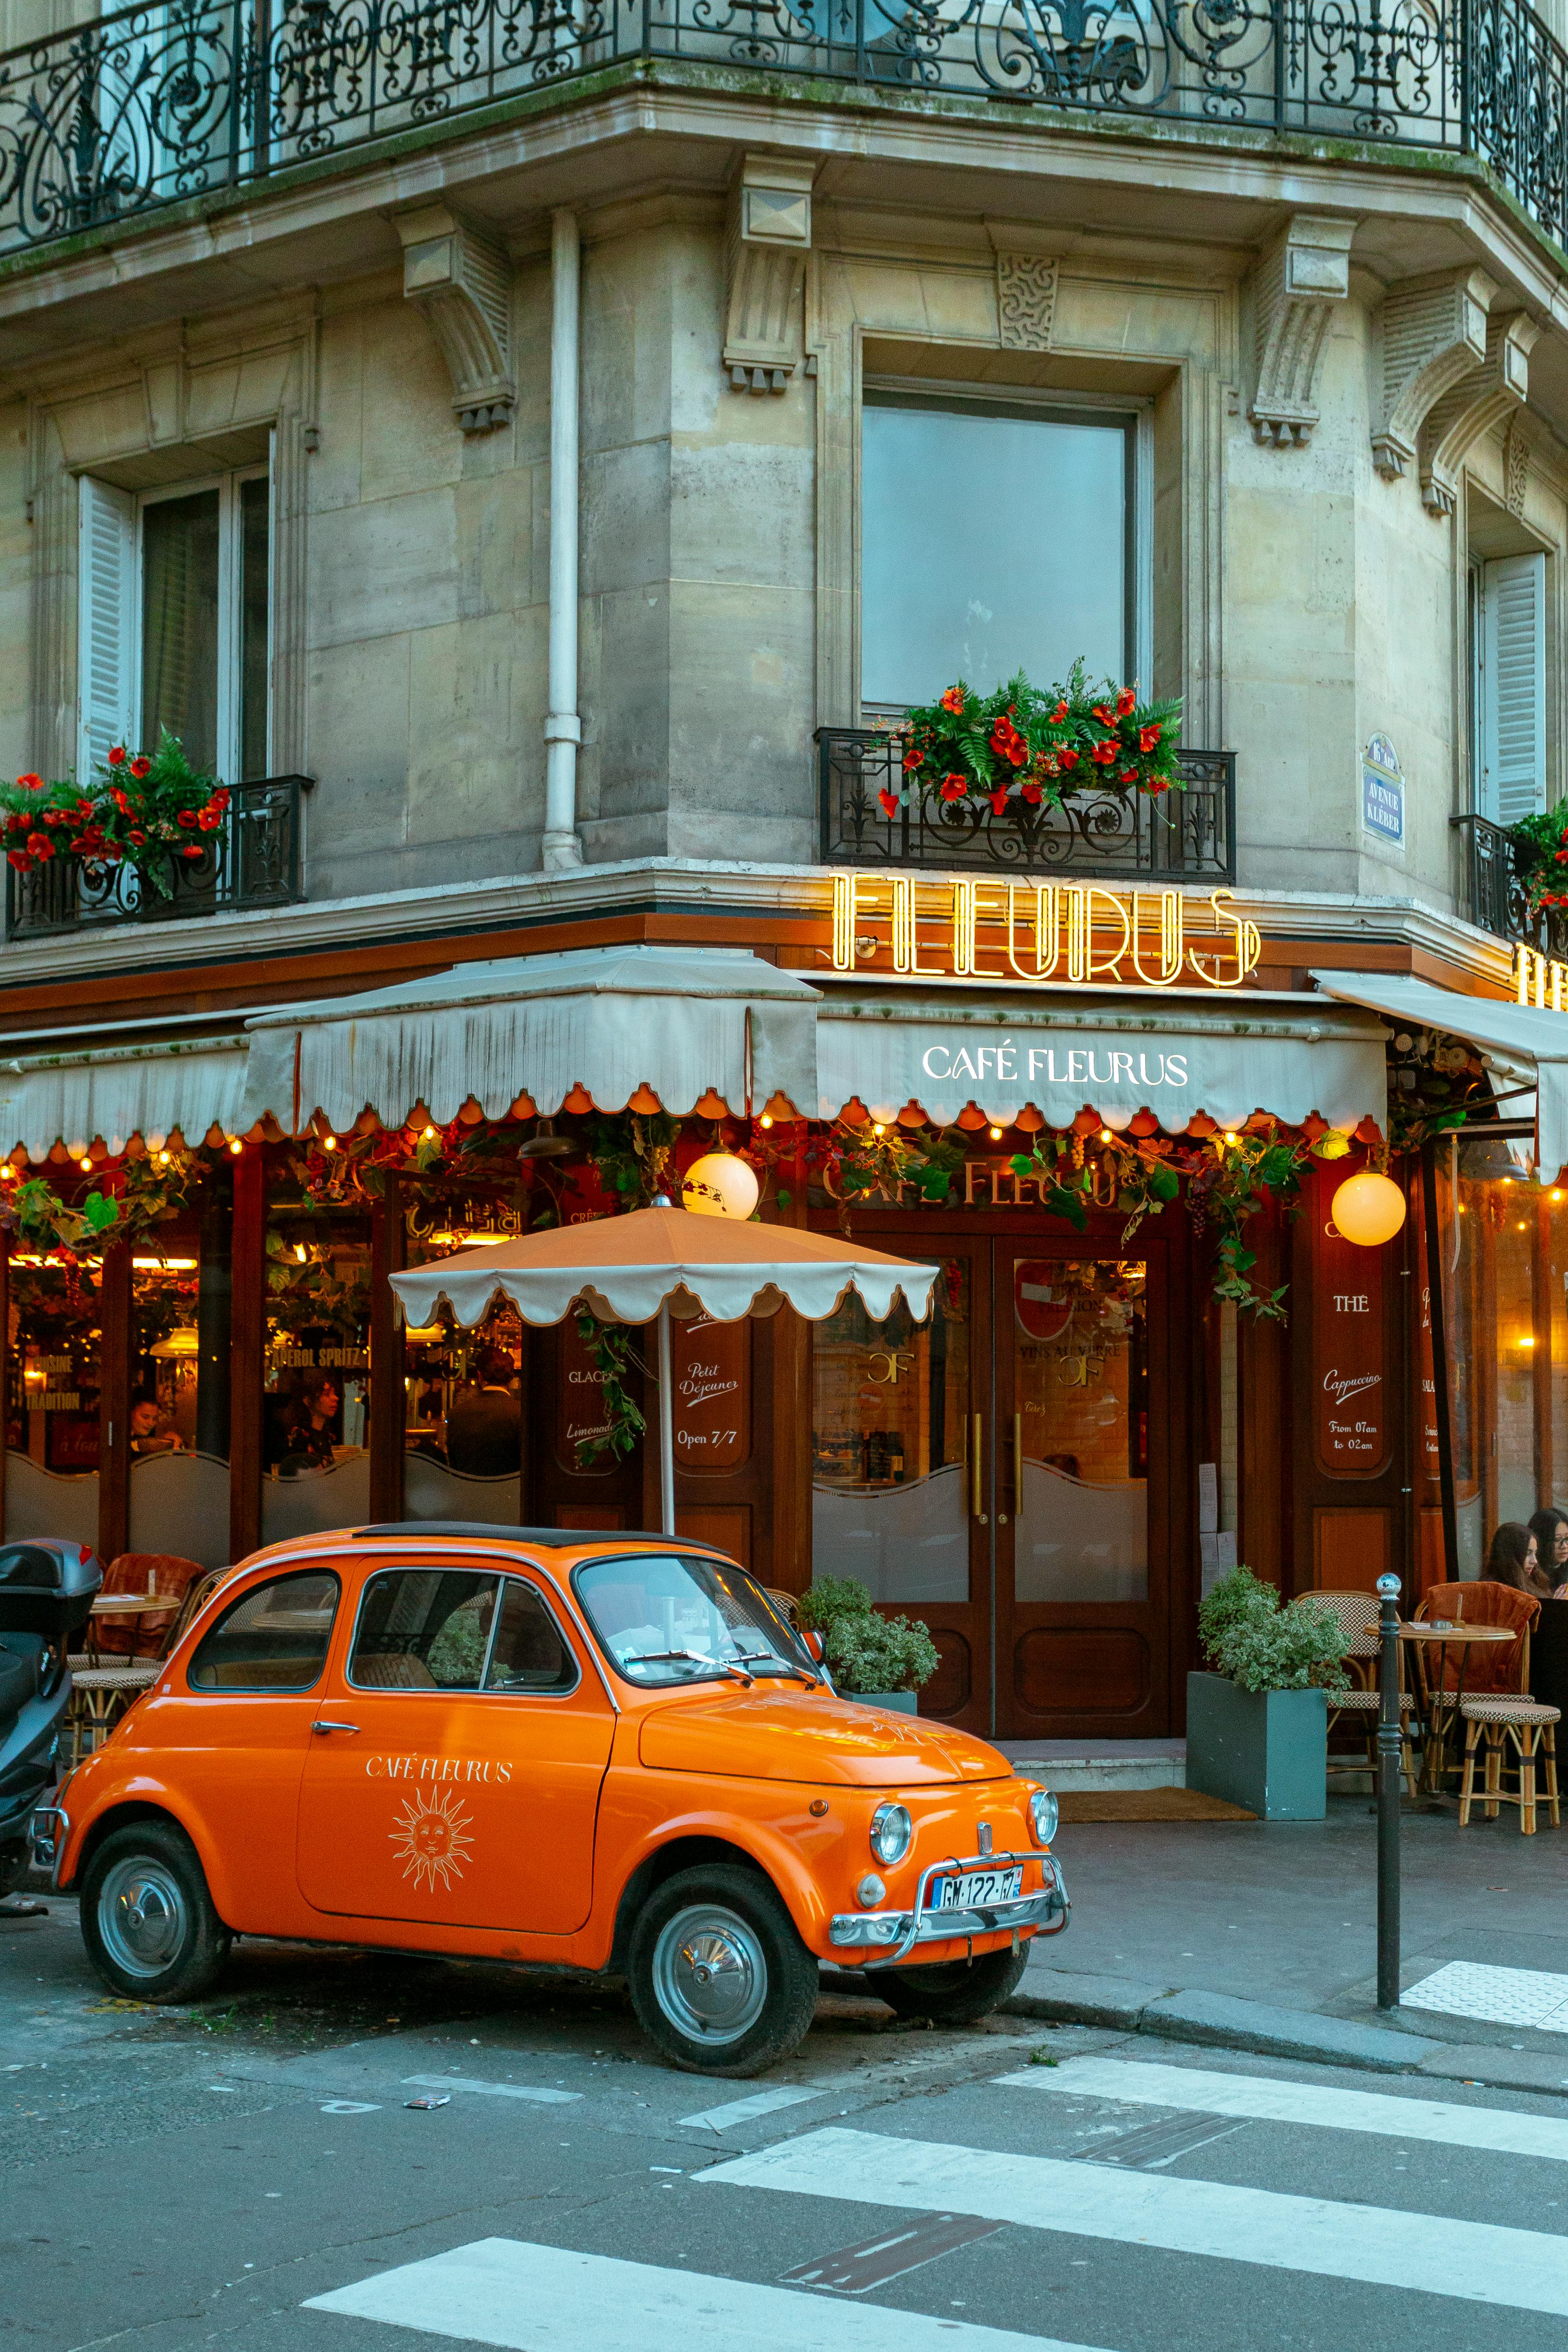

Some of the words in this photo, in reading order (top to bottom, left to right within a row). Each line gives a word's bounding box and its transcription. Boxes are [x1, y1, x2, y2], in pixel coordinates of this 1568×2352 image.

[1369, 782, 1399, 811] AVENUE
[1367, 802, 1400, 834] KLÉBER
[828, 872, 1261, 987] FLEURUS
[923, 1038, 1018, 1080] CAFÉ
[1028, 1048, 1189, 1087] FLEURUS
[1333, 1294, 1369, 1312] THÉ
[271, 1348, 315, 1367] APEROL
[318, 1347, 360, 1367] SPRITZ
[1020, 1346, 1050, 1358] VINS
[687, 1362, 721, 1378] Petit
[679, 1378, 738, 1407] Déjeuner
[1324, 1369, 1382, 1401] Cappuccino
[26, 1392, 80, 1410] TRADITION
[1328, 1420, 1352, 1433] From
[1355, 1422, 1378, 1433] 07am
[678, 1430, 707, 1450] Open
[711, 1430, 737, 1449] 7/7
[1334, 1440, 1344, 1450] to
[1348, 1440, 1373, 1450] 02am
[366, 1752, 417, 1779] CAFÉ
[420, 1758, 513, 1783] FLEURUS
